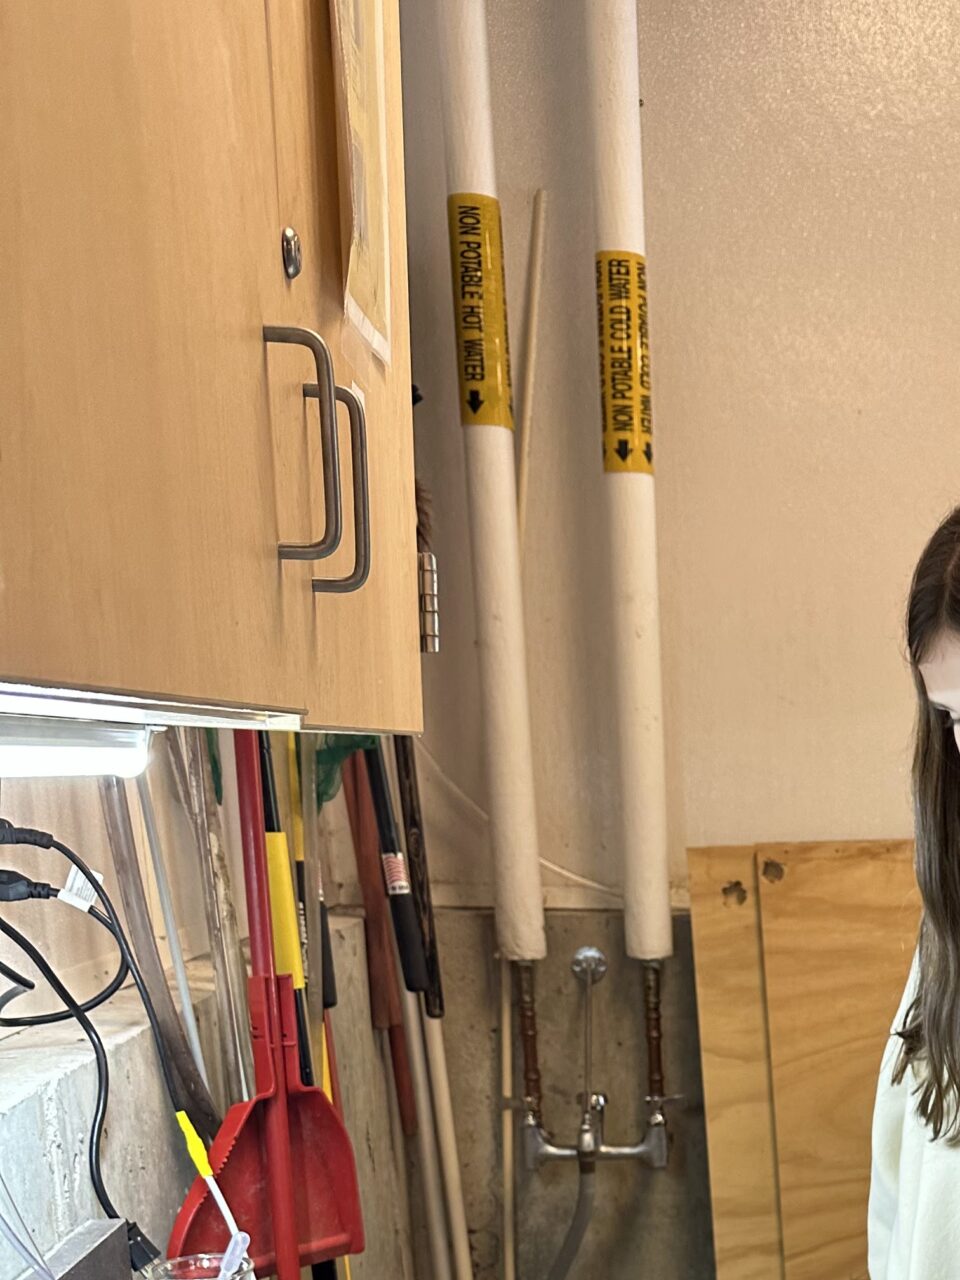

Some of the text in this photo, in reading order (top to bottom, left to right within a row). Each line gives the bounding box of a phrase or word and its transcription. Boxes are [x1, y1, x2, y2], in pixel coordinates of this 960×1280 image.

[457, 205, 485, 382] NON POTABLE HOT WATER
[608, 259, 634, 433] NON POTABLE COLD WATER
